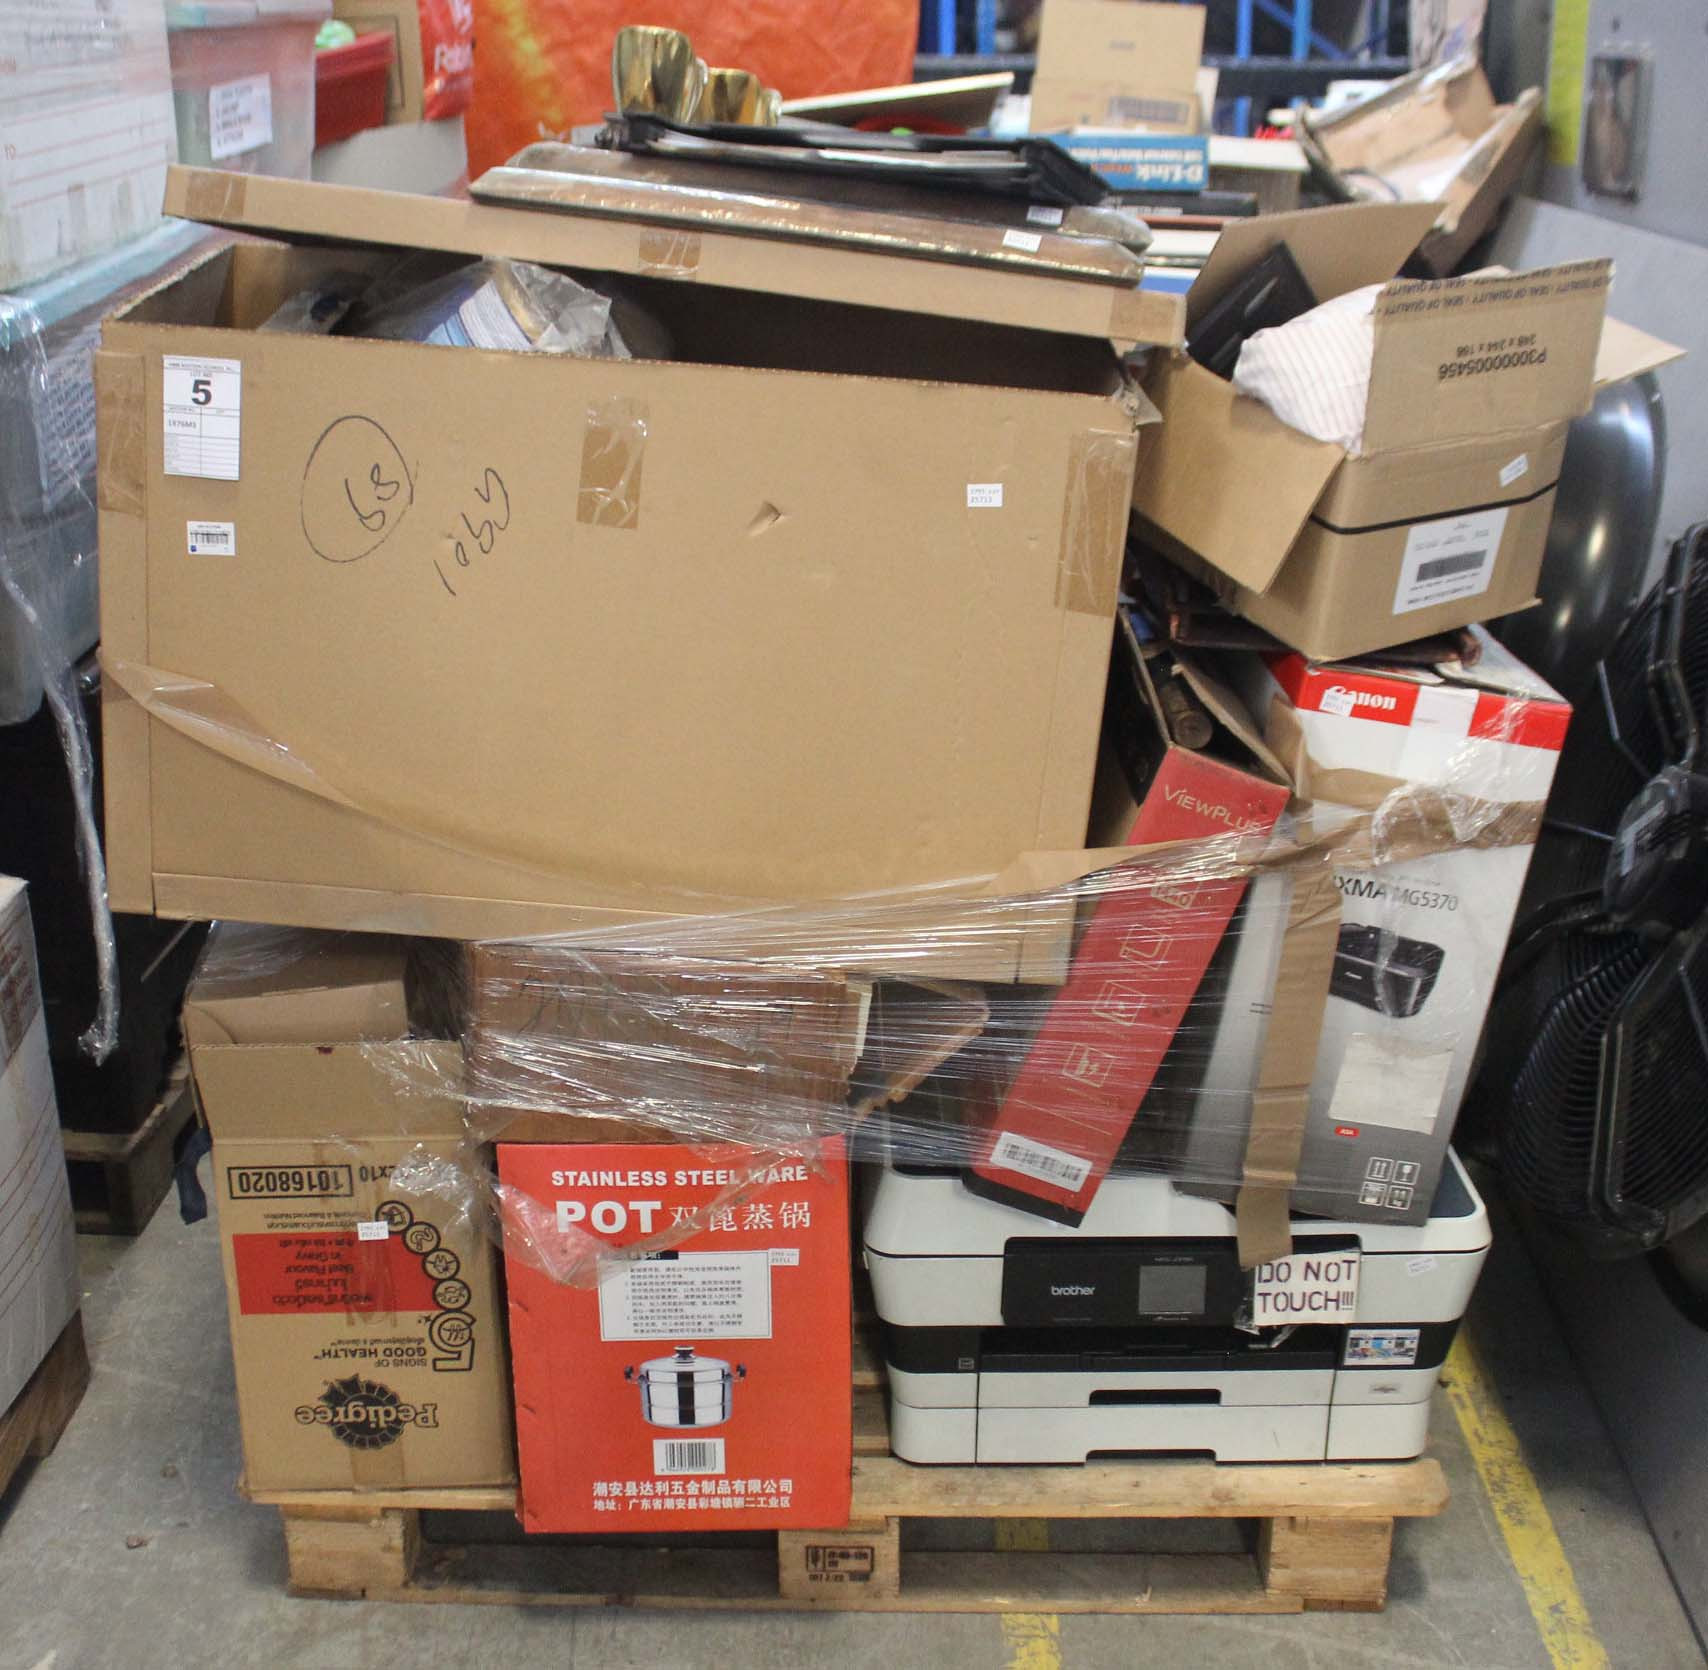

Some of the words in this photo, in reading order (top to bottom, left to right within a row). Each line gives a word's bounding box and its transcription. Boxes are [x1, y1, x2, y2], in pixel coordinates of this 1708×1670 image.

[1136, 163, 1204, 182] D-Link
[191, 379, 213, 406] 5
[238, 1171, 343, 1193] 10168020
[551, 1170, 668, 1187] STAINLESS
[674, 1168, 740, 1186] STEEL
[746, 1165, 809, 1185] WARE
[556, 1200, 662, 1233] POT
[1257, 1262, 1291, 1283] DO
[1303, 1259, 1357, 1283] NOT
[1051, 1284, 1095, 1297] brother
[1257, 1290, 1355, 1313] TOUCH!!!
[374, 1359, 390, 1368] OF
[382, 1347, 427, 1358] GOOD
[392, 1359, 427, 1367] SIGNS
[294, 1401, 439, 1428] Pedigree
